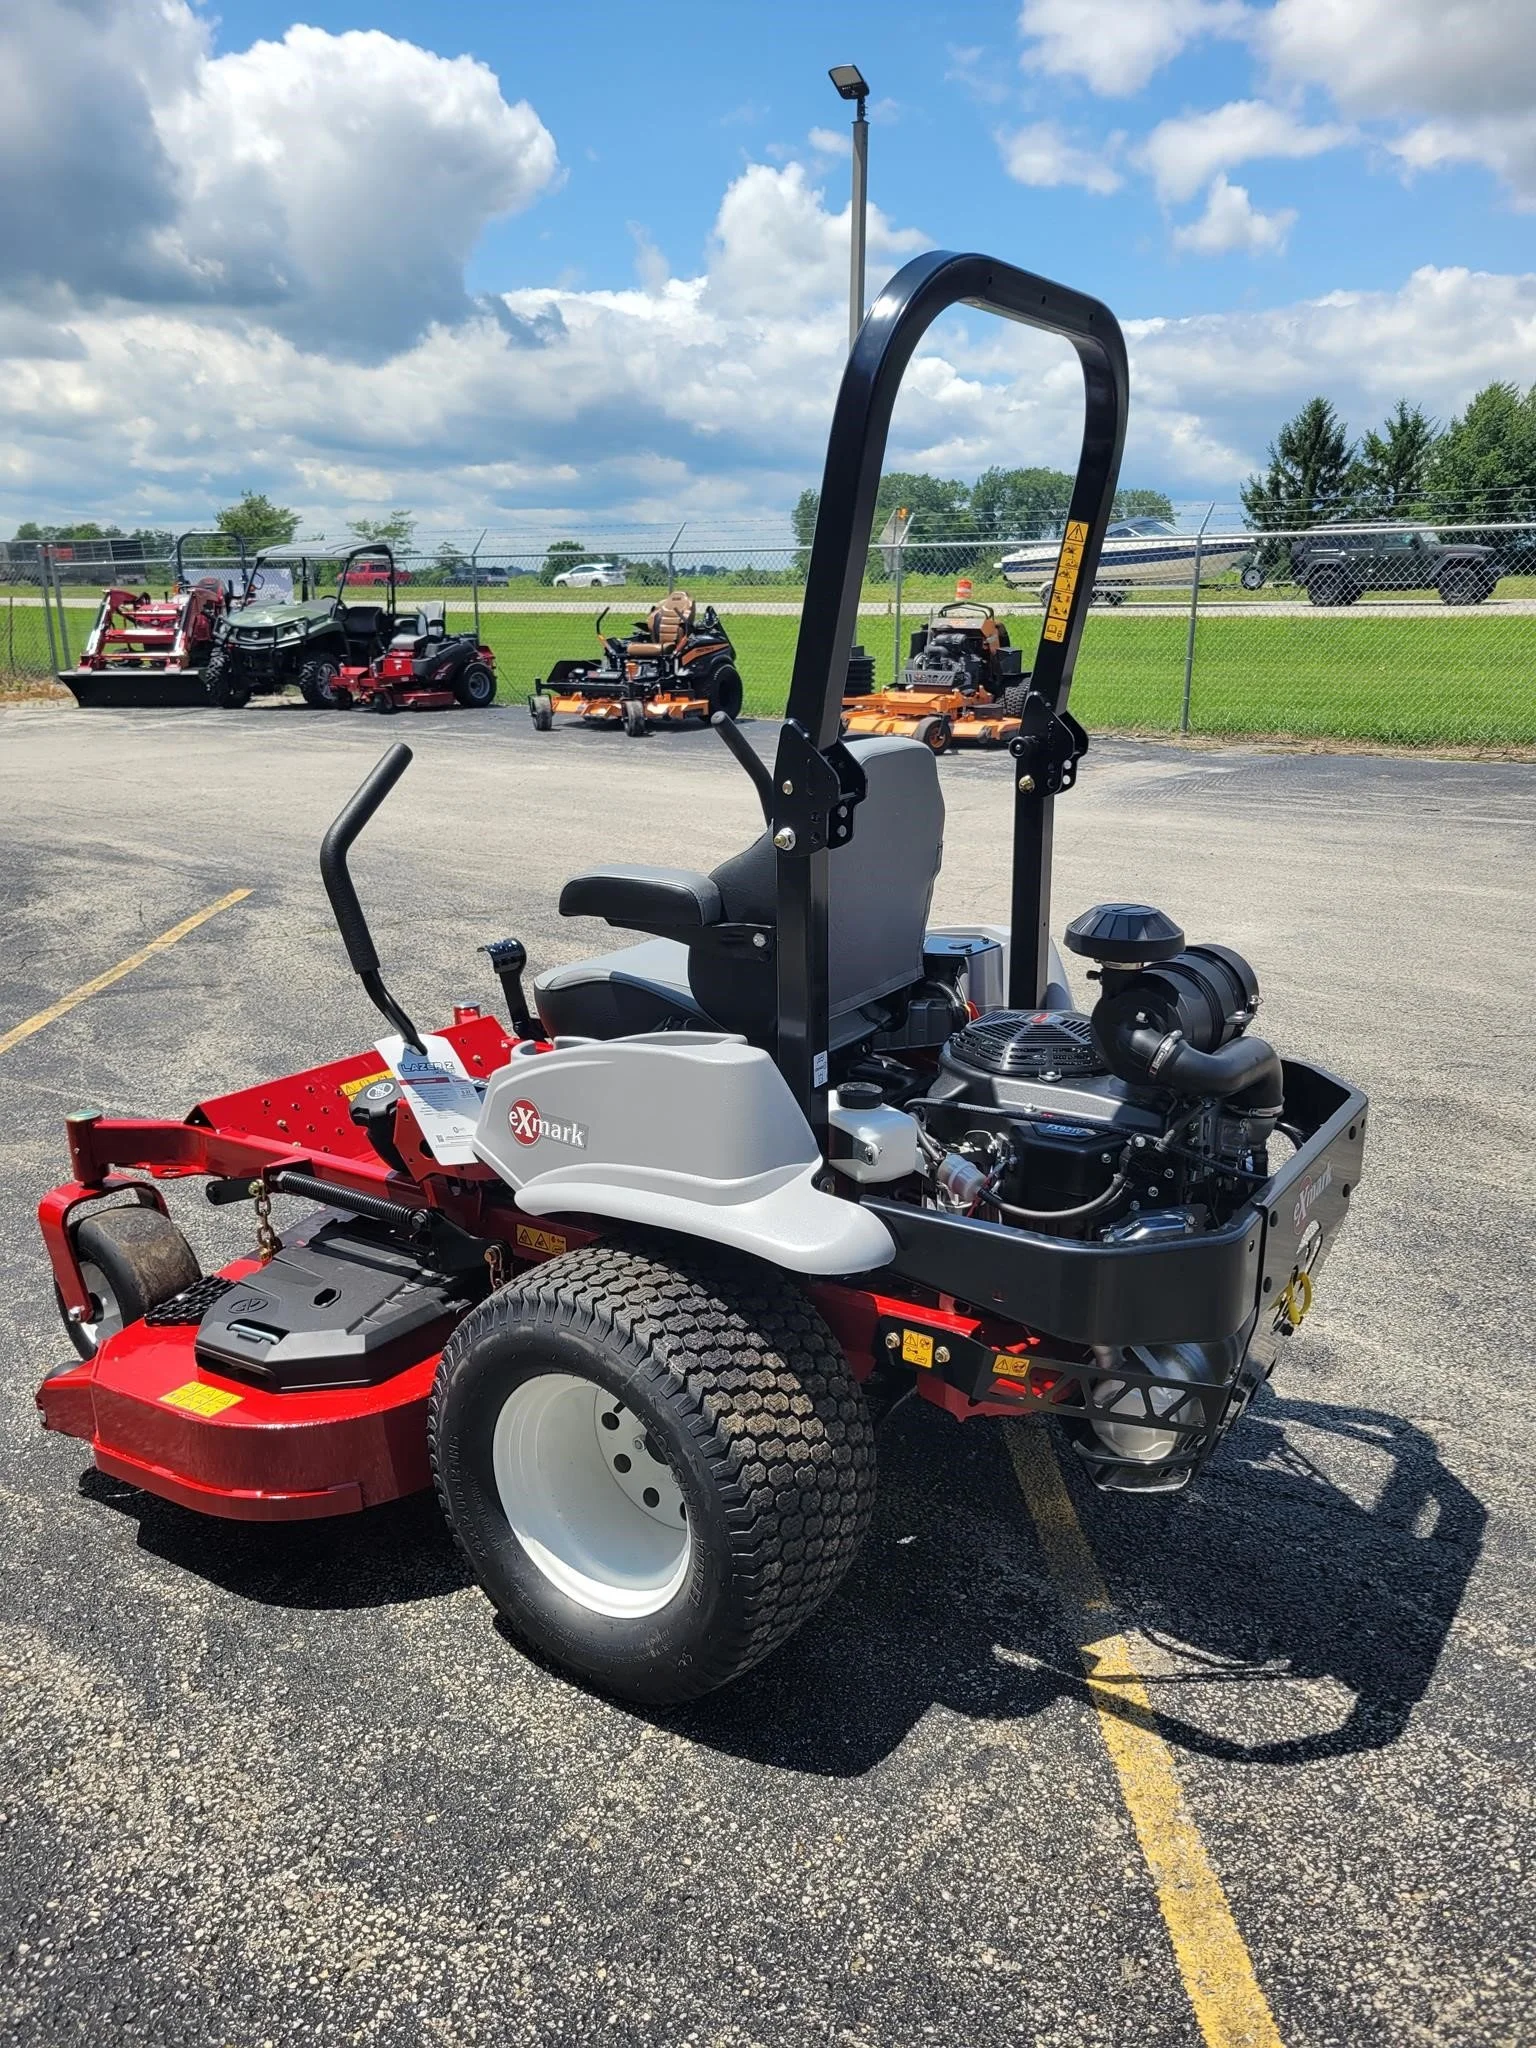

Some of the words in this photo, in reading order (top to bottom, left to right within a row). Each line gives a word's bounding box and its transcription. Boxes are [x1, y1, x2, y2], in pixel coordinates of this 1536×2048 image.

[401, 1062, 443, 1072] LAZER
[445, 1061, 455, 1070] Z
[508, 1106, 585, 1147] eXmark
[1294, 1160, 1333, 1227] eXmark
